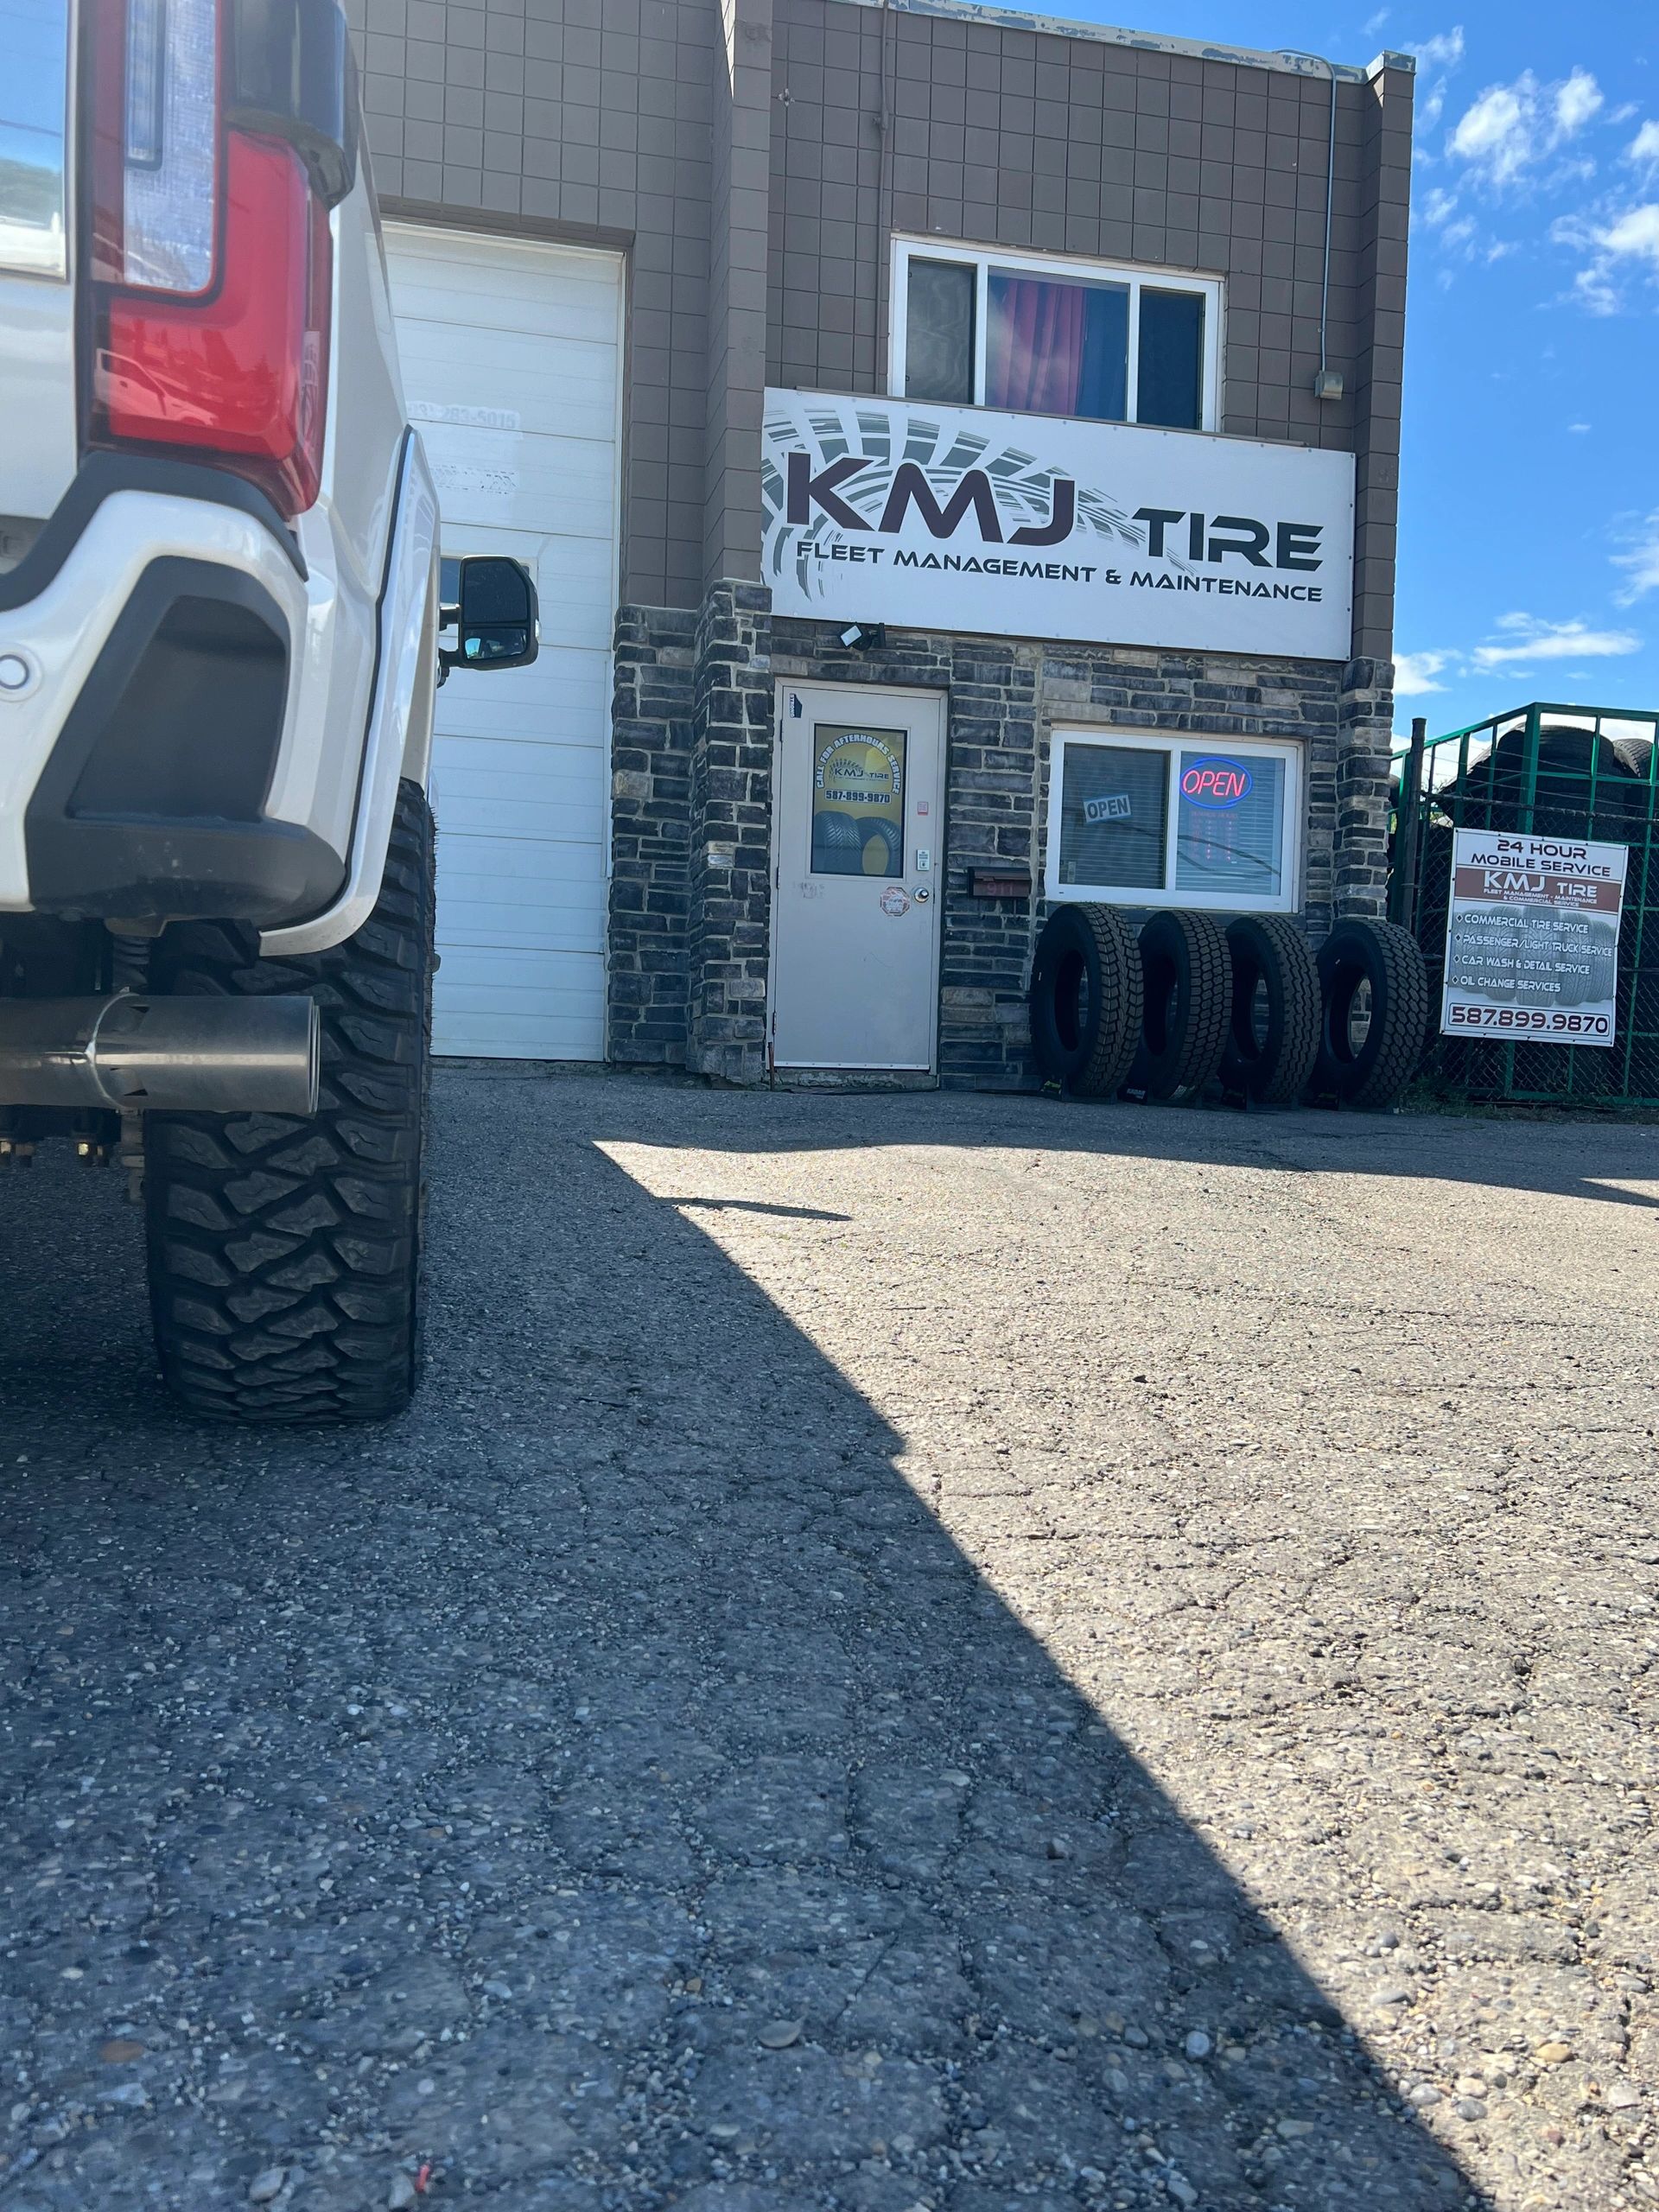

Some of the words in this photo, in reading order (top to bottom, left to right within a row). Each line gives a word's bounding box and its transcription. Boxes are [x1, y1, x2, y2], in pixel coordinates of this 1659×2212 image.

[786, 451, 1076, 547] KMJ
[1131, 507, 1324, 572] TIRE
[797, 541, 885, 564] FLEET
[893, 550, 1097, 582] MANAGEMENT
[1105, 569, 1122, 585] &
[1129, 570, 1323, 602] MAINTENANCE
[833, 734, 890, 755] AFTERHOURS
[819, 746, 835, 765] FOR
[816, 765, 825, 789] CALL
[835, 768, 864, 778] KMJ
[887, 754, 901, 794] SERVICE
[1182, 770, 1245, 798] OPEN
[826, 790, 890, 804] 587-899-9870
[1086, 798, 1128, 819] OPEN
[1497, 839, 1523, 854] 24
[1530, 842, 1587, 860] HOUR
[1471, 853, 1535, 869] MOBILE
[1541, 860, 1611, 877] SERVICE
[1484, 870, 1546, 892] KMJ
[1557, 882, 1598, 898] TIRE
[1503, 890, 1549, 899] MANAGEMENT
[1554, 895, 1597, 905] MAINTENANCE
[1509, 896, 1553, 905] COMMERCIAL
[1464, 914, 1529, 928] COMMERCIAL
[1531, 918, 1551, 931] TIRE
[1552, 921, 1589, 934] SERVICE
[1463, 934, 1549, 950] PASSENGER/LIGHT
[1551, 942, 1579, 954] TRUCK
[1580, 944, 1613, 957] SERVICE
[1461, 955, 1484, 965] CAR
[1486, 956, 1514, 969] WASH
[1516, 959, 1522, 969] &
[1523, 960, 1553, 971] DETAIL
[1554, 963, 1591, 975] SERVICE
[1460, 975, 1475, 986] OIL
[1478, 976, 1516, 988] CHANGE
[1516, 979, 1561, 993] SERVICES
[1452, 1006, 1608, 1033] 587.899.9870
